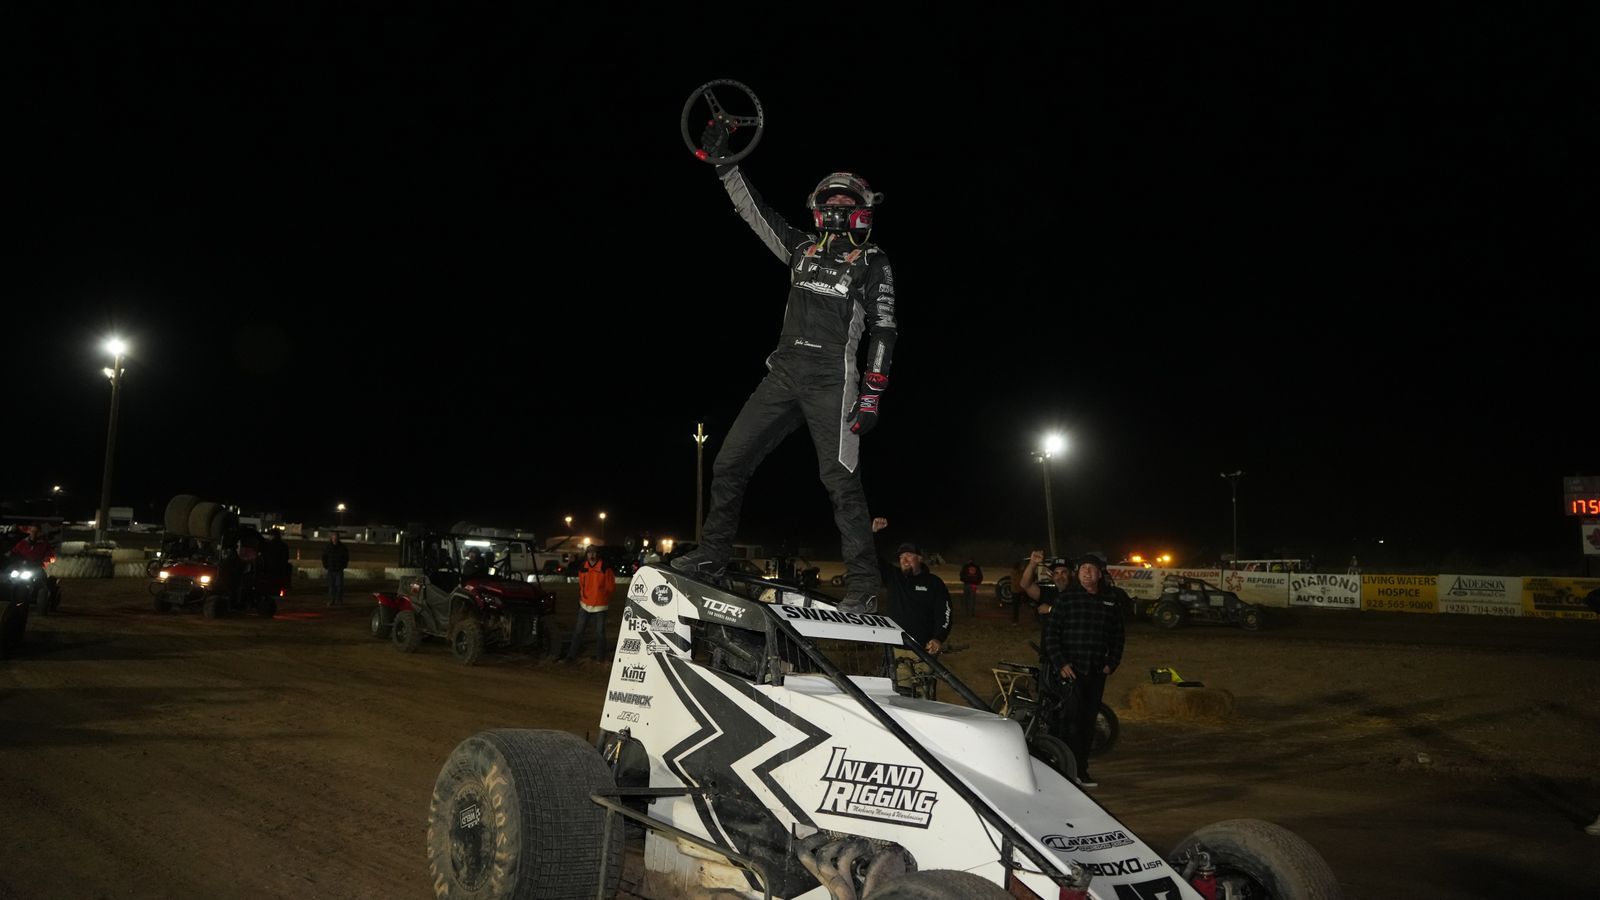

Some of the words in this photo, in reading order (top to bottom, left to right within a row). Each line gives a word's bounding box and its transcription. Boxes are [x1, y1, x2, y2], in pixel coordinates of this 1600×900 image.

[1183, 570, 1220, 578] COLLISION
[1246, 576, 1285, 585] REPUBLIC
[1362, 576, 1395, 585] LIVING
[1397, 576, 1437, 585] WATERS
[1291, 575, 1359, 593] DIAMOND
[1448, 576, 1506, 594] ANDERSON
[1296, 595, 1324, 603] AUTO
[1327, 596, 1355, 604] SALES
[1377, 588, 1421, 597] HOSPICE
[781, 605, 895, 629] SWANSON
[621, 666, 646, 683] King
[608, 690, 653, 707] MAVERICK
[617, 710, 640, 723] JFM
[820, 746, 924, 790] INLAND
[815, 780, 938, 816] RIGGING
[1143, 860, 1163, 870] USA
